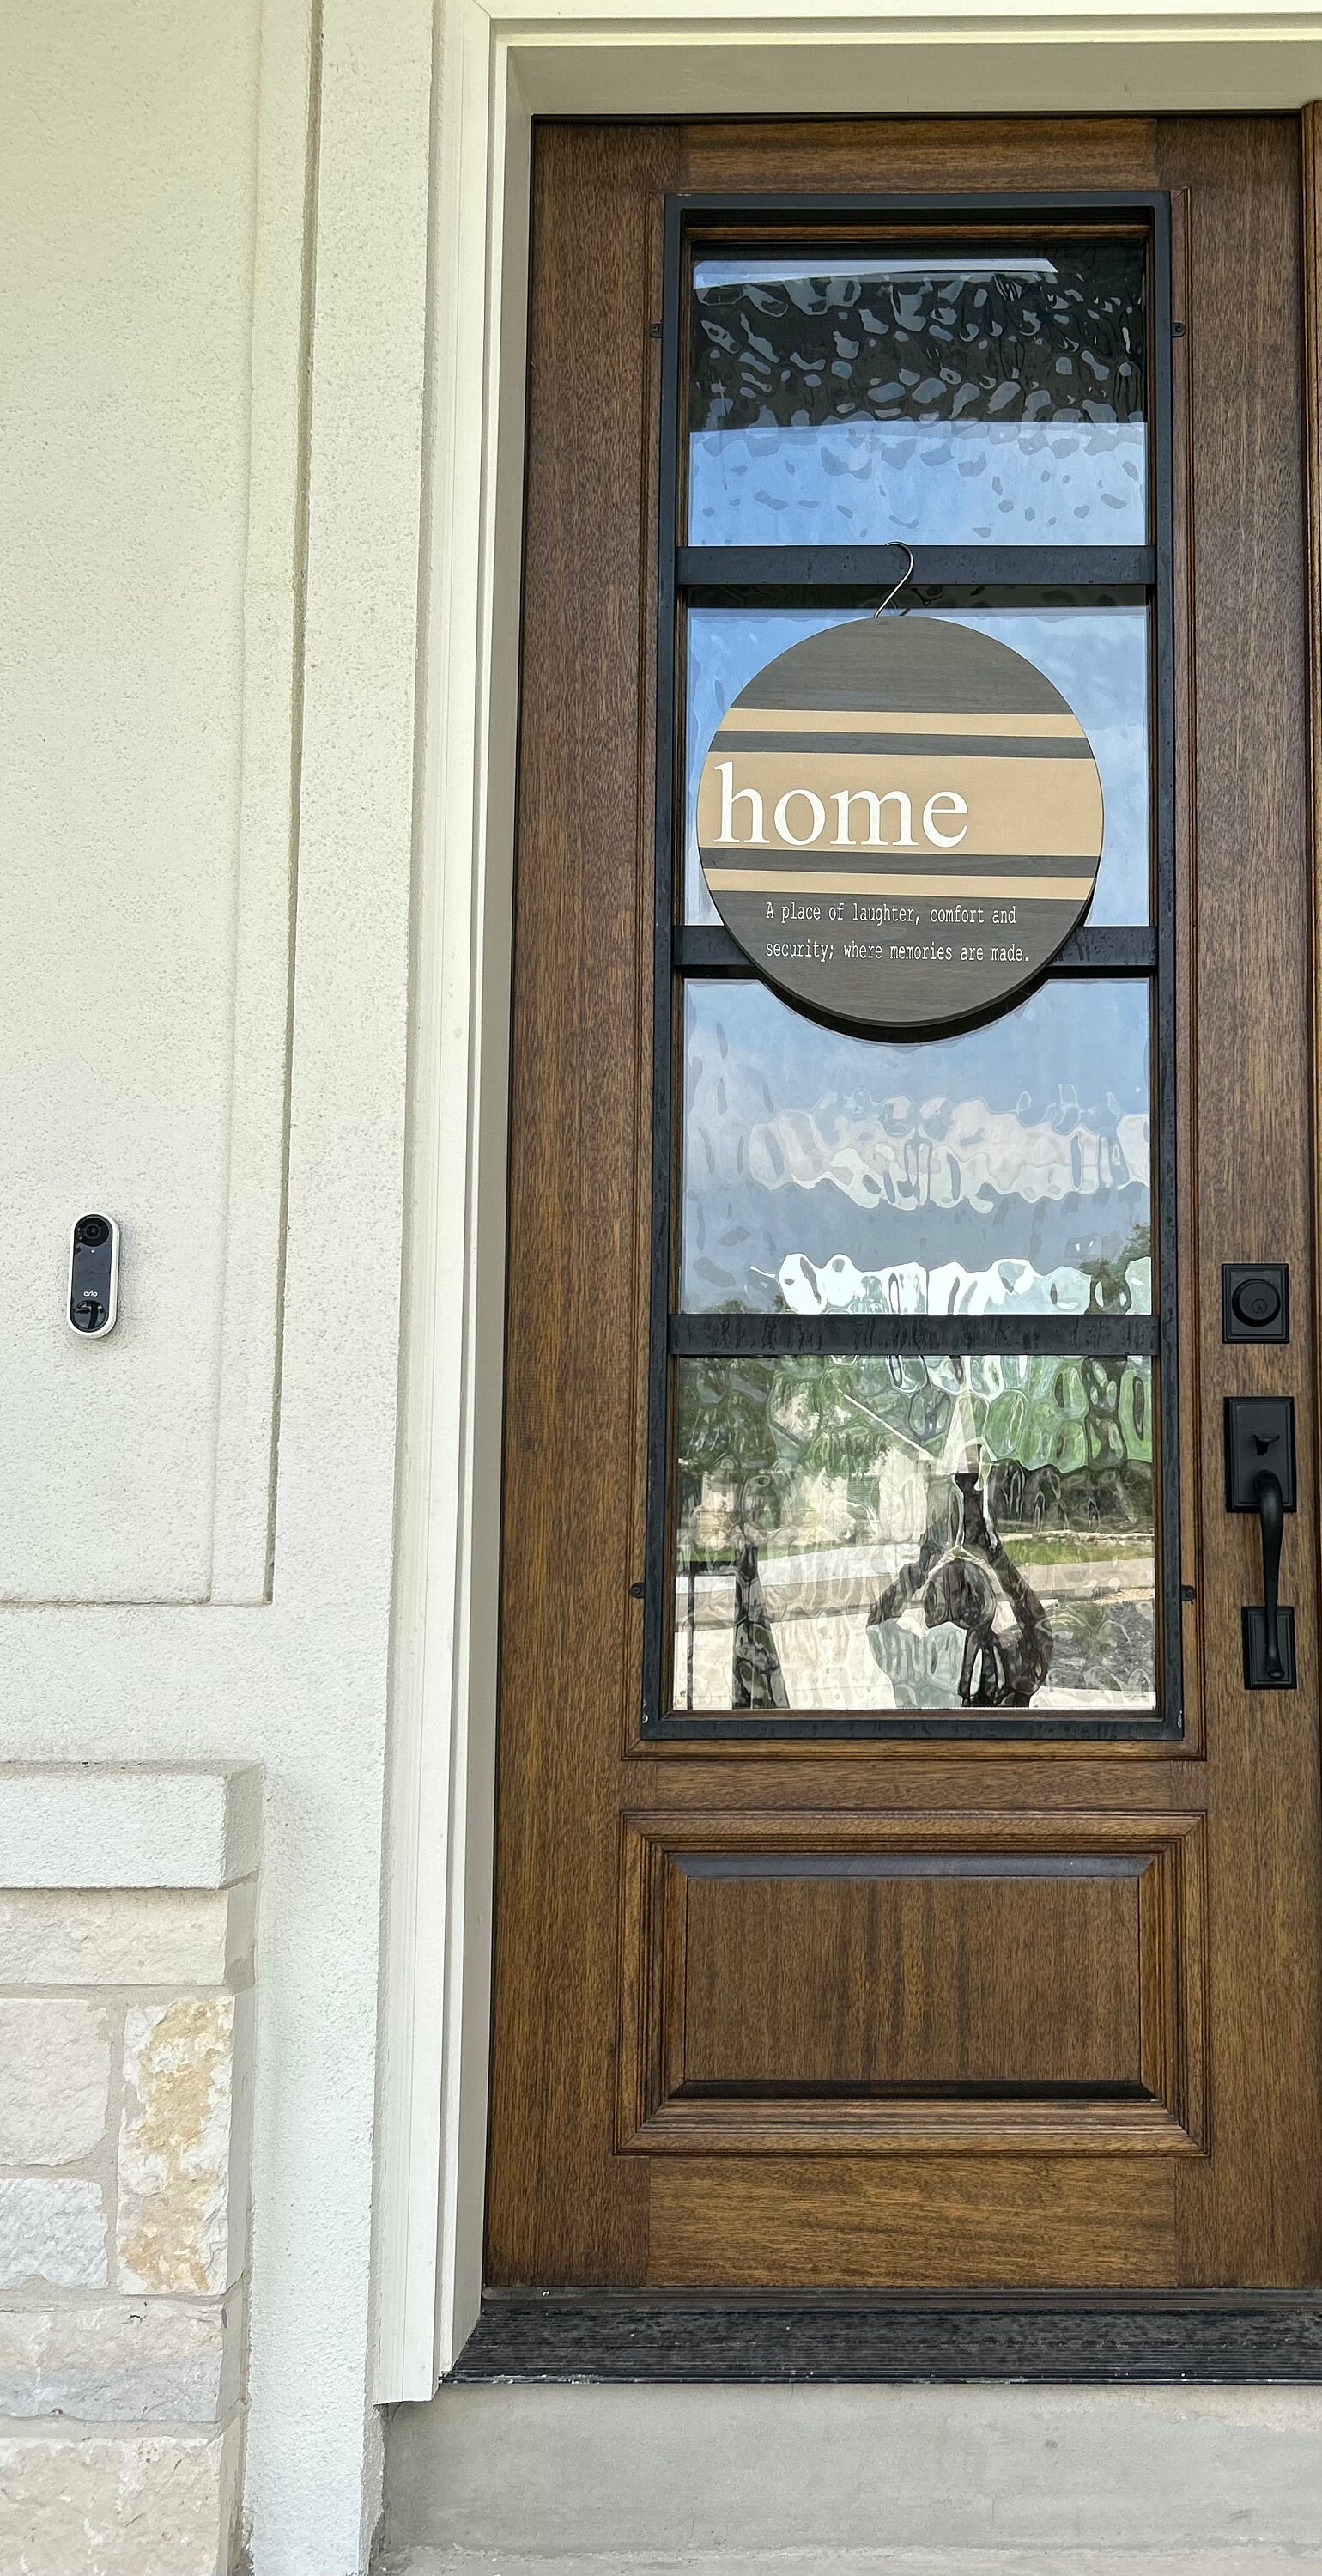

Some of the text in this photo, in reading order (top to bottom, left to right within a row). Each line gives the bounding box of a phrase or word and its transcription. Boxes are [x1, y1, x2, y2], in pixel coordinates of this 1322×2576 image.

[713, 761, 968, 848] home
[765, 901, 1016, 926] A place of laughter, comfort and
[765, 939, 1029, 963] security; where memories are made.
